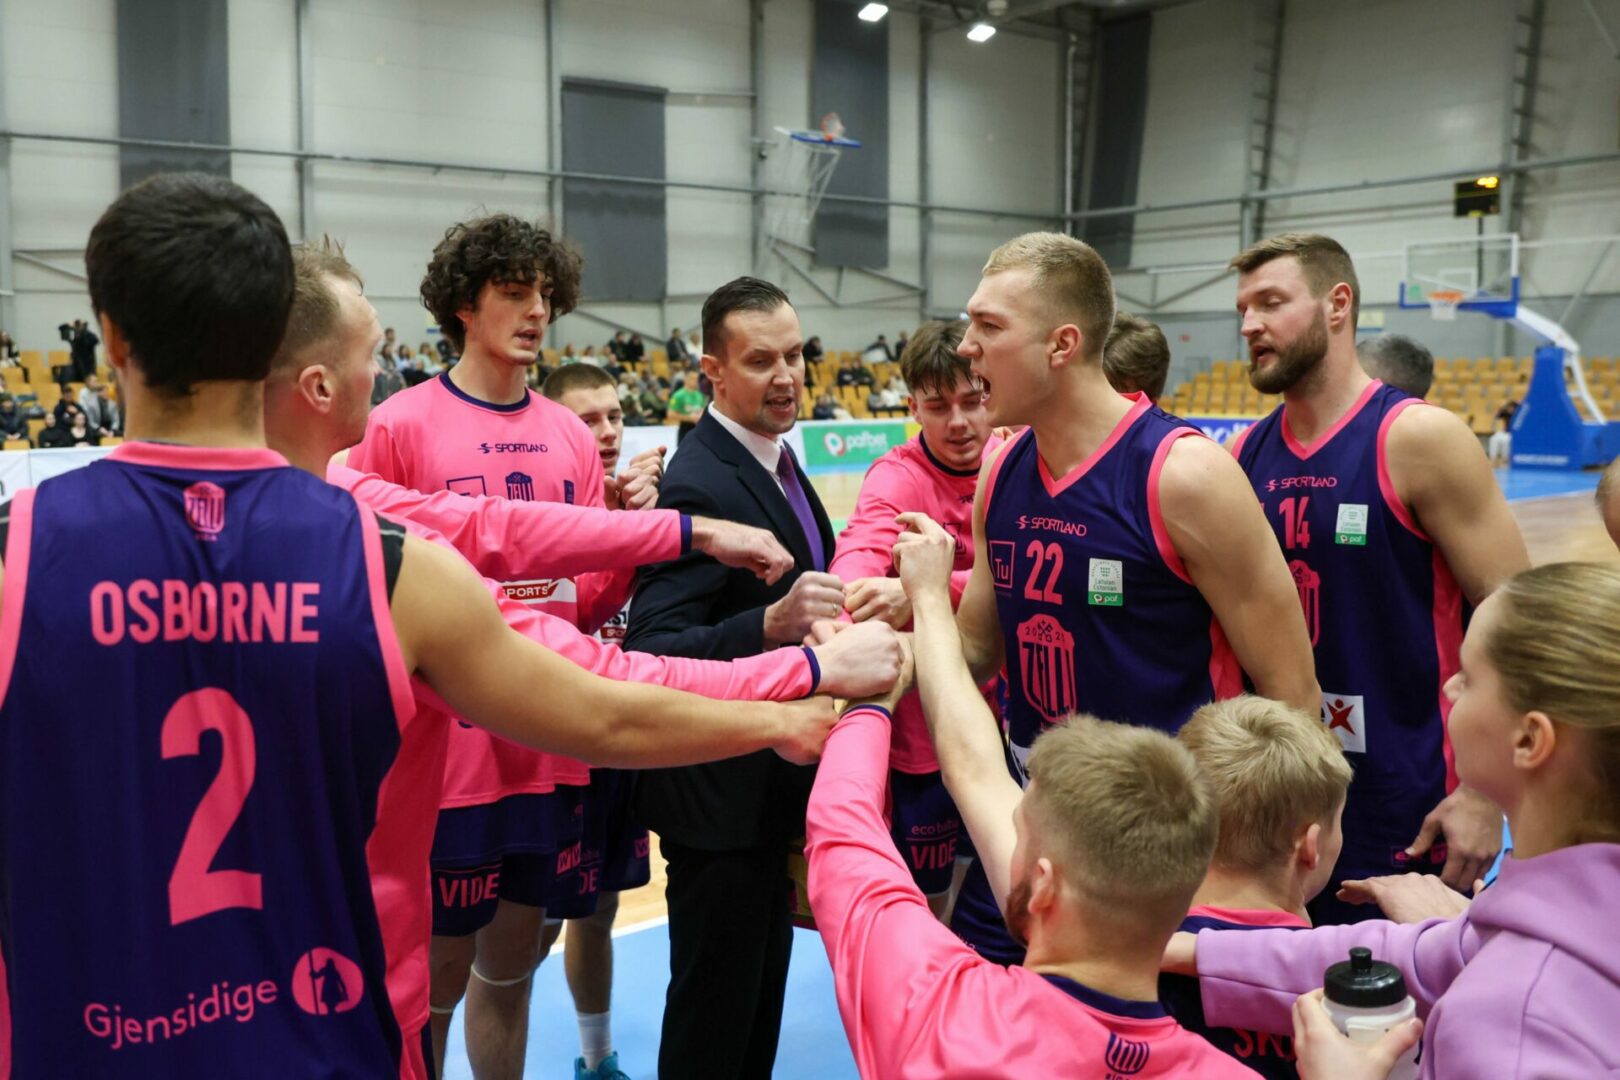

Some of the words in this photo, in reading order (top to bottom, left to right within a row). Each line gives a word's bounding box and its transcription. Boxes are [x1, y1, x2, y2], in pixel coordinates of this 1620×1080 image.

[495, 442, 549, 454] SPORTLAND
[1280, 476, 1338, 489] SPORTLAND
[1031, 517, 1087, 537] SPORTLAND
[1279, 496, 1310, 549] 14
[995, 558, 1009, 579] Tu
[1024, 540, 1064, 605] 22
[503, 585, 549, 597] PORTS
[89, 579, 321, 646] OSBORNE
[161, 687, 263, 926] 2
[911, 838, 957, 870] VIDE
[438, 873, 499, 908] VIDE
[84, 978, 278, 1050] Gjensidige
